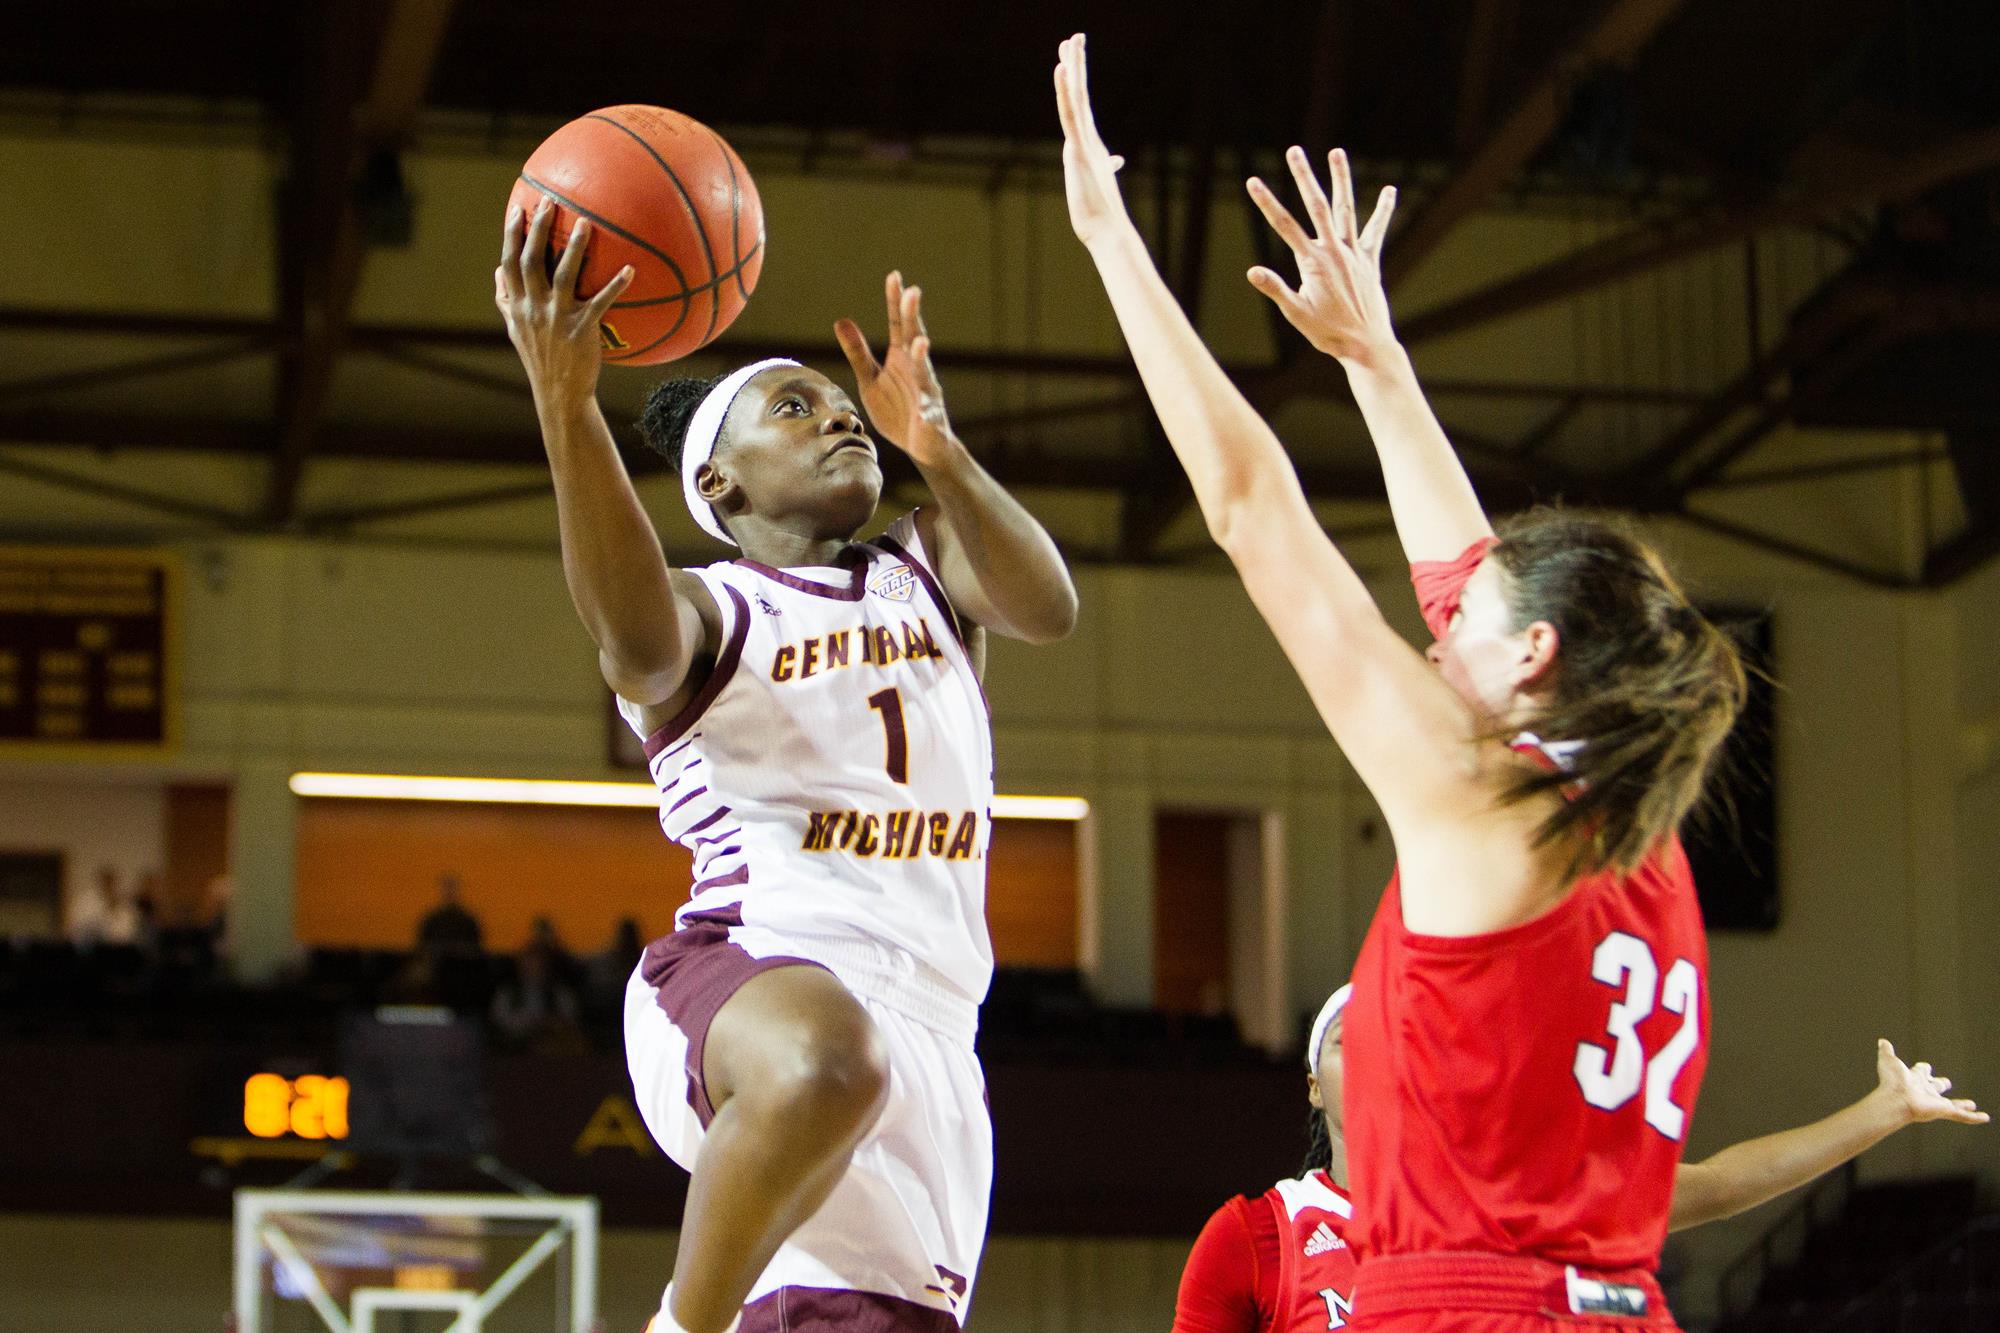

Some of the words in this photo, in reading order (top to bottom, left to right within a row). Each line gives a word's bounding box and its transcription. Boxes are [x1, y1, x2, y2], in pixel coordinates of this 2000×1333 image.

[868, 687, 909, 784] 1
[801, 809, 981, 860] MICHIGA
[1573, 930, 1699, 1143] 32
[1303, 1238, 1347, 1257] adidas
